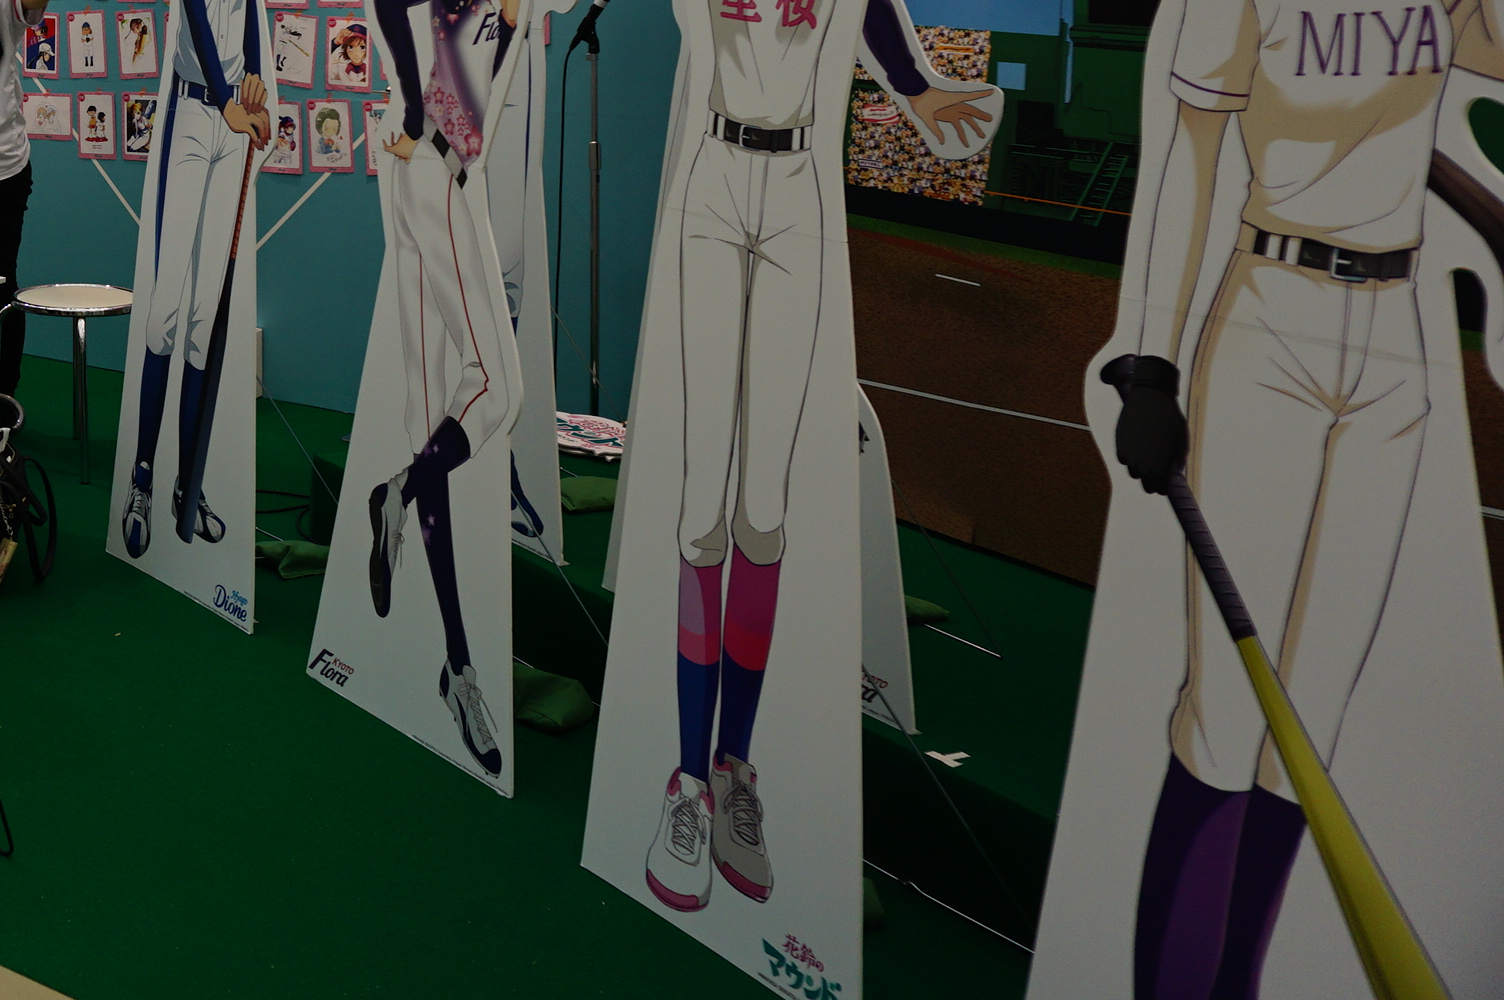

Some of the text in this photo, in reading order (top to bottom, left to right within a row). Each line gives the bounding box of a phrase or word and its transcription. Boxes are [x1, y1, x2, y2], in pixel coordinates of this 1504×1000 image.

[473, 13, 501, 45] Flo
[1294, 4, 1444, 77] MIYA
[213, 584, 248, 622] Dione
[309, 648, 349, 687] Flora
[332, 657, 355, 675] KYOTO
[761, 937, 843, 1000] マウンド
[781, 932, 825, 973] 花鈴の
